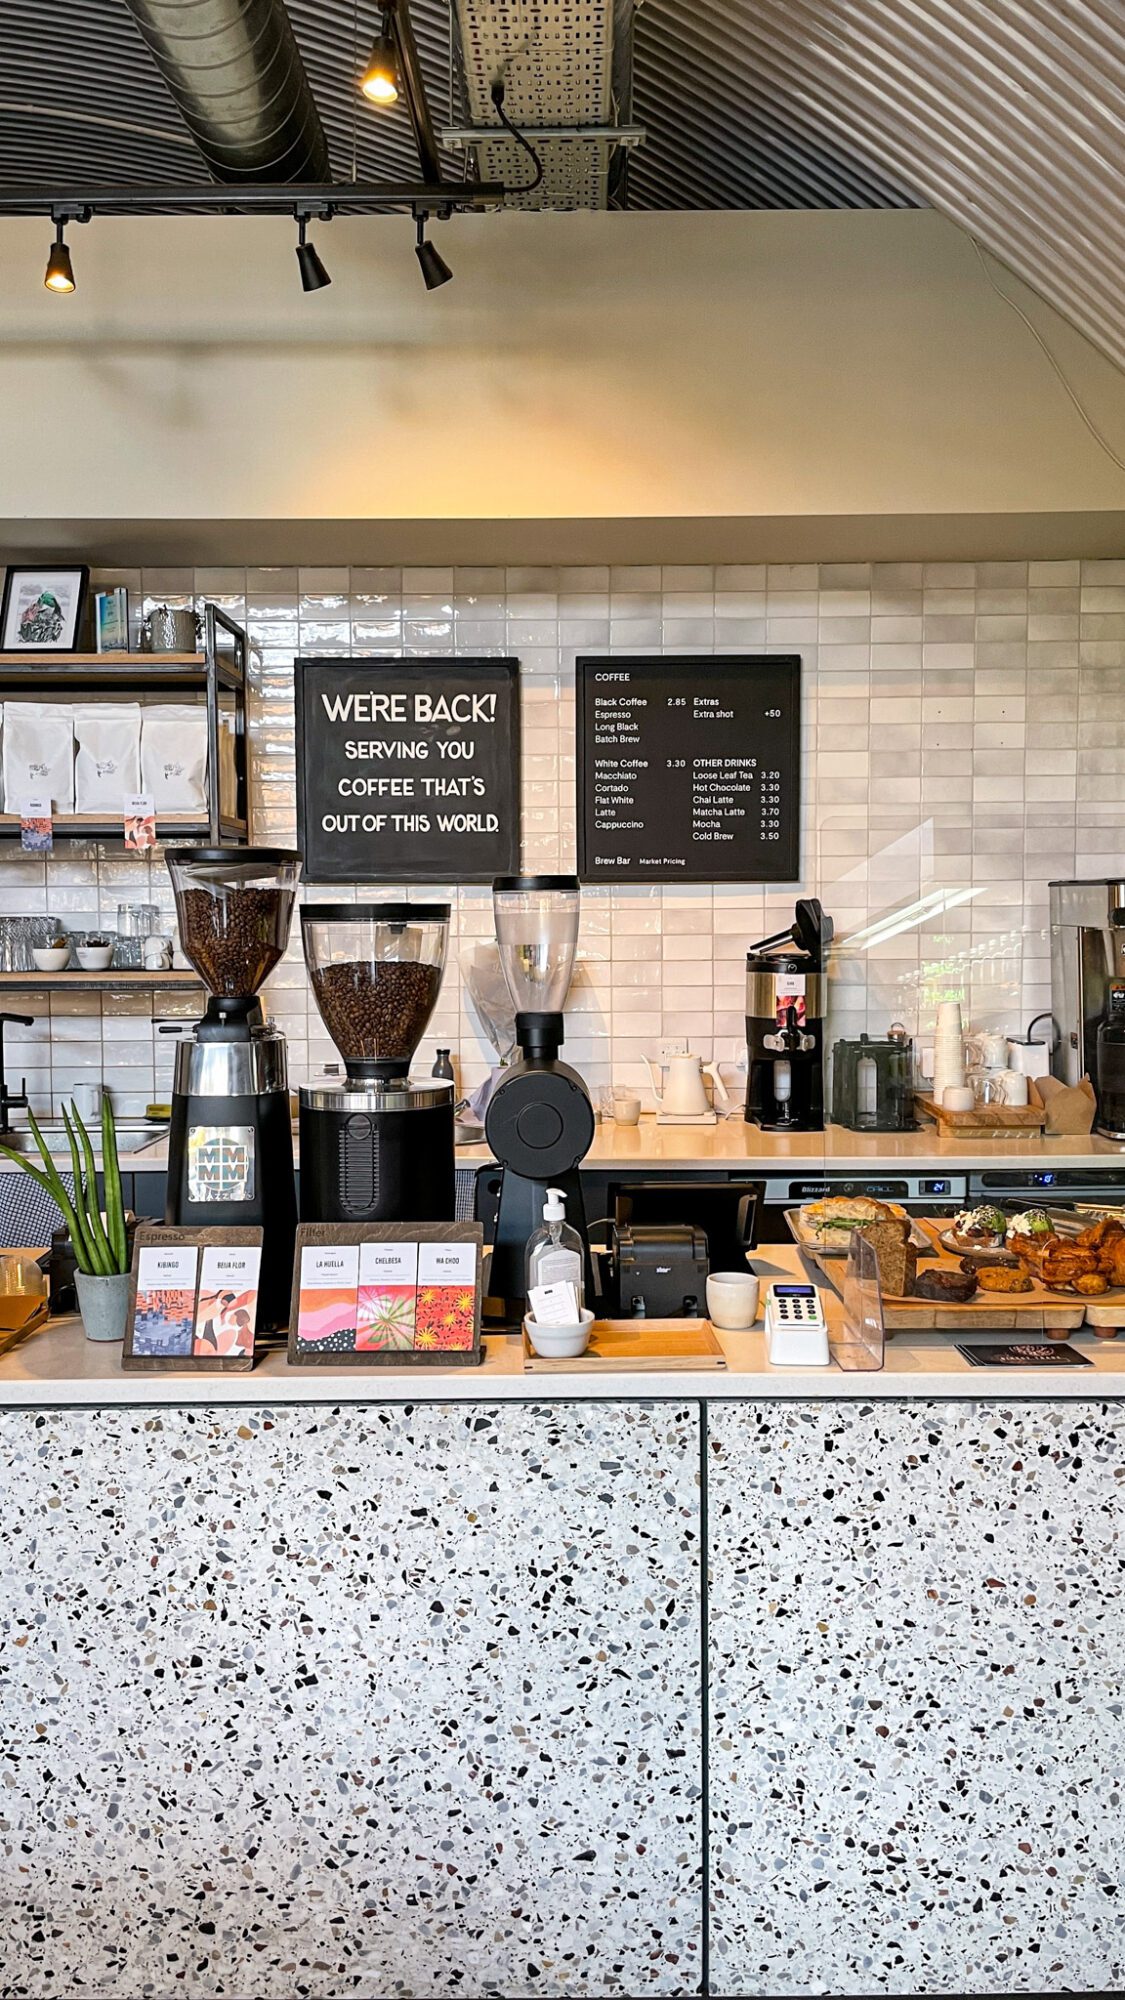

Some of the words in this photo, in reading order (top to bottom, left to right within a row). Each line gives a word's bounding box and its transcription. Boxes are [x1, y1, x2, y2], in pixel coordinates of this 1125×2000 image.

[595, 673, 631, 681] COFFEE
[595, 698, 617, 706] Black
[619, 698, 648, 706] Coffee
[667, 698, 687, 706] 2.85
[693, 698, 720, 706] Extras
[414, 694, 497, 723] BACK!
[595, 711, 631, 720] Espresso
[693, 710, 715, 718] Extra
[716, 710, 734, 718] shot
[595, 723, 615, 732] Long
[617, 723, 639, 731] Black
[595, 735, 618, 743] Batch
[620, 735, 640, 743] Brew
[345, 741, 429, 759] SERVING
[436, 741, 475, 759] YOU
[595, 759, 618, 768] White
[620, 759, 649, 768] Coffee
[666, 759, 686, 768] 3.30
[693, 759, 723, 767] OTHER
[724, 759, 757, 767] DRINKS
[595, 772, 637, 780] Macchiato
[693, 771, 718, 779] Loose
[720, 771, 737, 779] Leaf
[739, 771, 753, 779] Tea
[761, 771, 780, 779] 3.20
[338, 778, 414, 796] COFFEE
[420, 775, 486, 796] THAT'S
[595, 784, 629, 792] Cortado
[693, 783, 708, 791] Hot
[709, 783, 751, 791] Chocolate
[760, 783, 780, 791] 3.30
[595, 796, 609, 804] Flat
[611, 796, 634, 804] White
[693, 796, 712, 804] Chai
[713, 796, 734, 804] Latte
[760, 796, 780, 804] 3.30
[595, 808, 616, 816] Latte
[693, 808, 723, 816] Matcha
[724, 808, 746, 816] Latte
[761, 808, 780, 816] 3.70
[321, 815, 360, 832] OUT
[361, 815, 387, 832] OF
[390, 815, 431, 832] THIS
[436, 814, 499, 832] WORLD.
[595, 820, 644, 830] Cappuccino
[693, 820, 721, 828] Mocha
[760, 820, 780, 828] 3.30
[692, 832, 712, 840] Cold
[713, 832, 734, 840] Brew
[760, 832, 780, 840] 3.50
[595, 857, 615, 865] Brew
[617, 857, 631, 865] Bar
[663, 858, 686, 866] Pricing
[300, 1227, 326, 1237] Filter
[140, 1231, 185, 1242] Espresso
